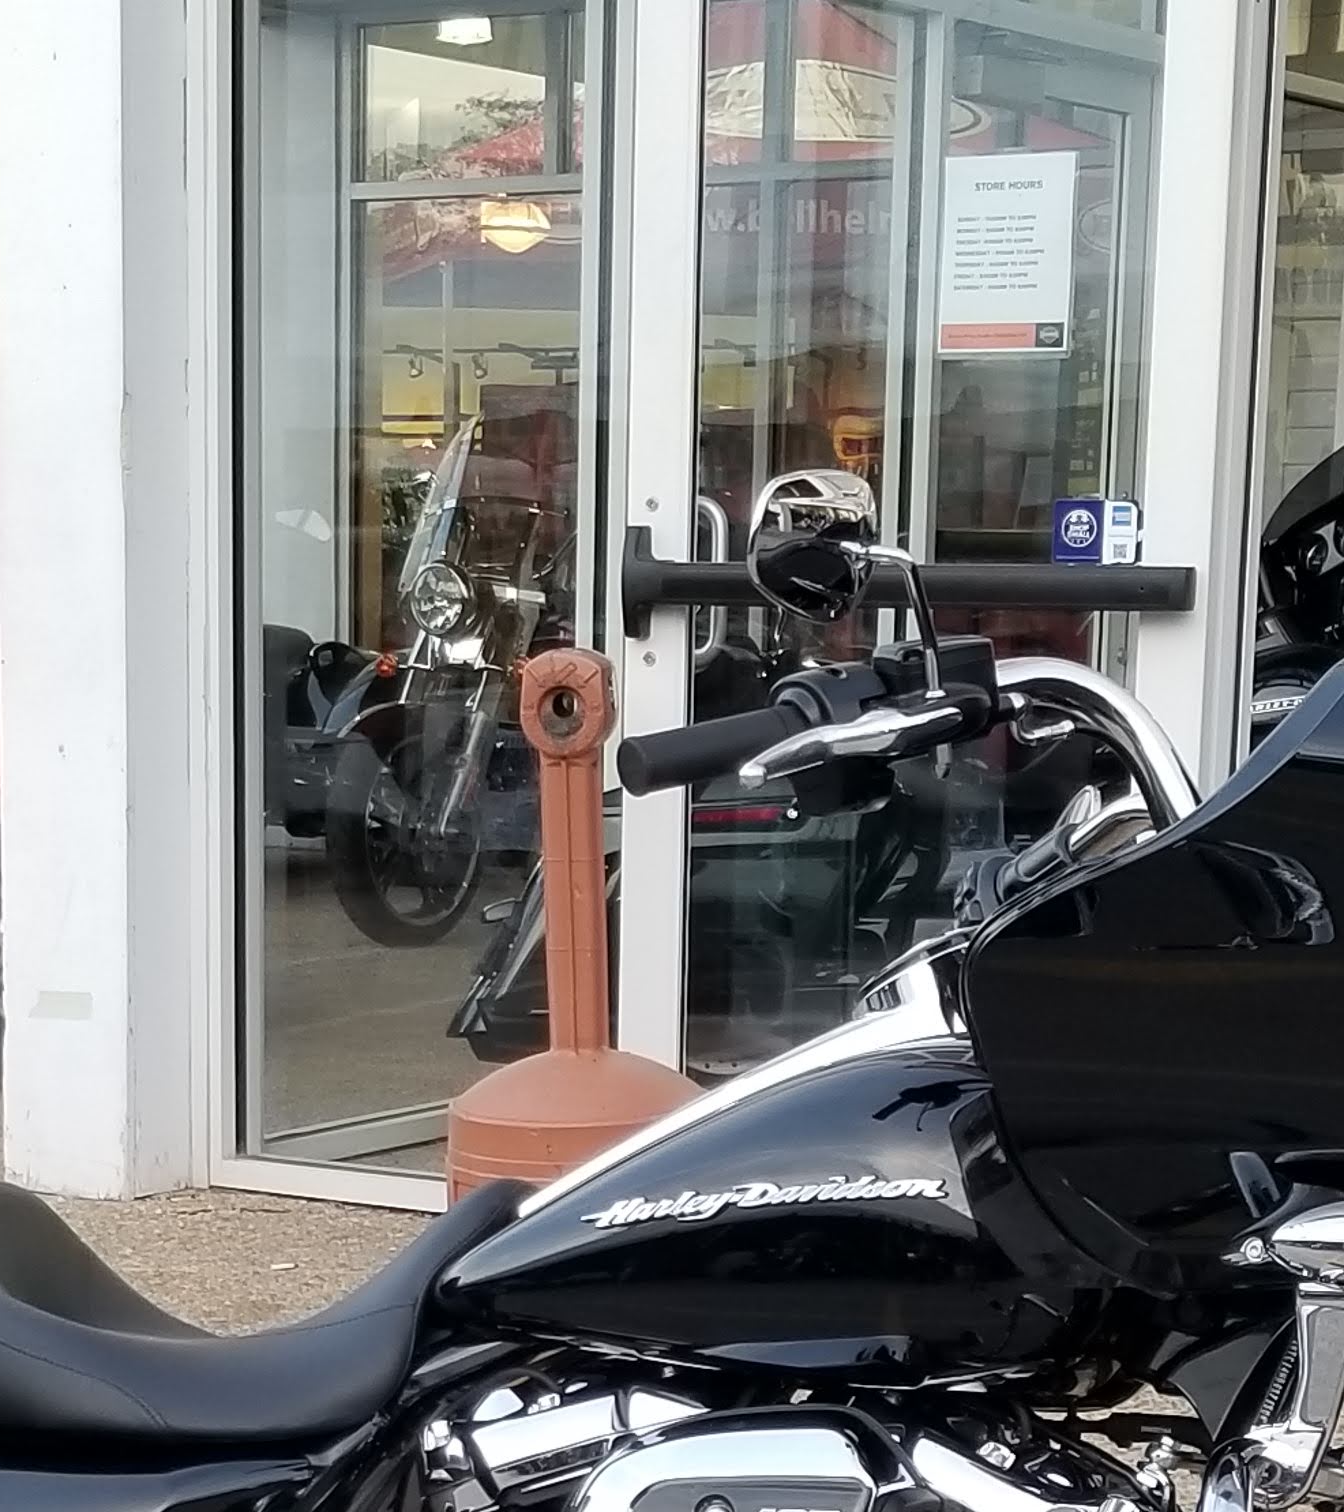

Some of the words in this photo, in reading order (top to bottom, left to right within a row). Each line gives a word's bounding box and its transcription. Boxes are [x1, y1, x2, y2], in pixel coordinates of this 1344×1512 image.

[975, 182, 1005, 191] STORE
[1008, 180, 1043, 190] HOURS
[580, 1175, 950, 1229] Harley-Davidson
